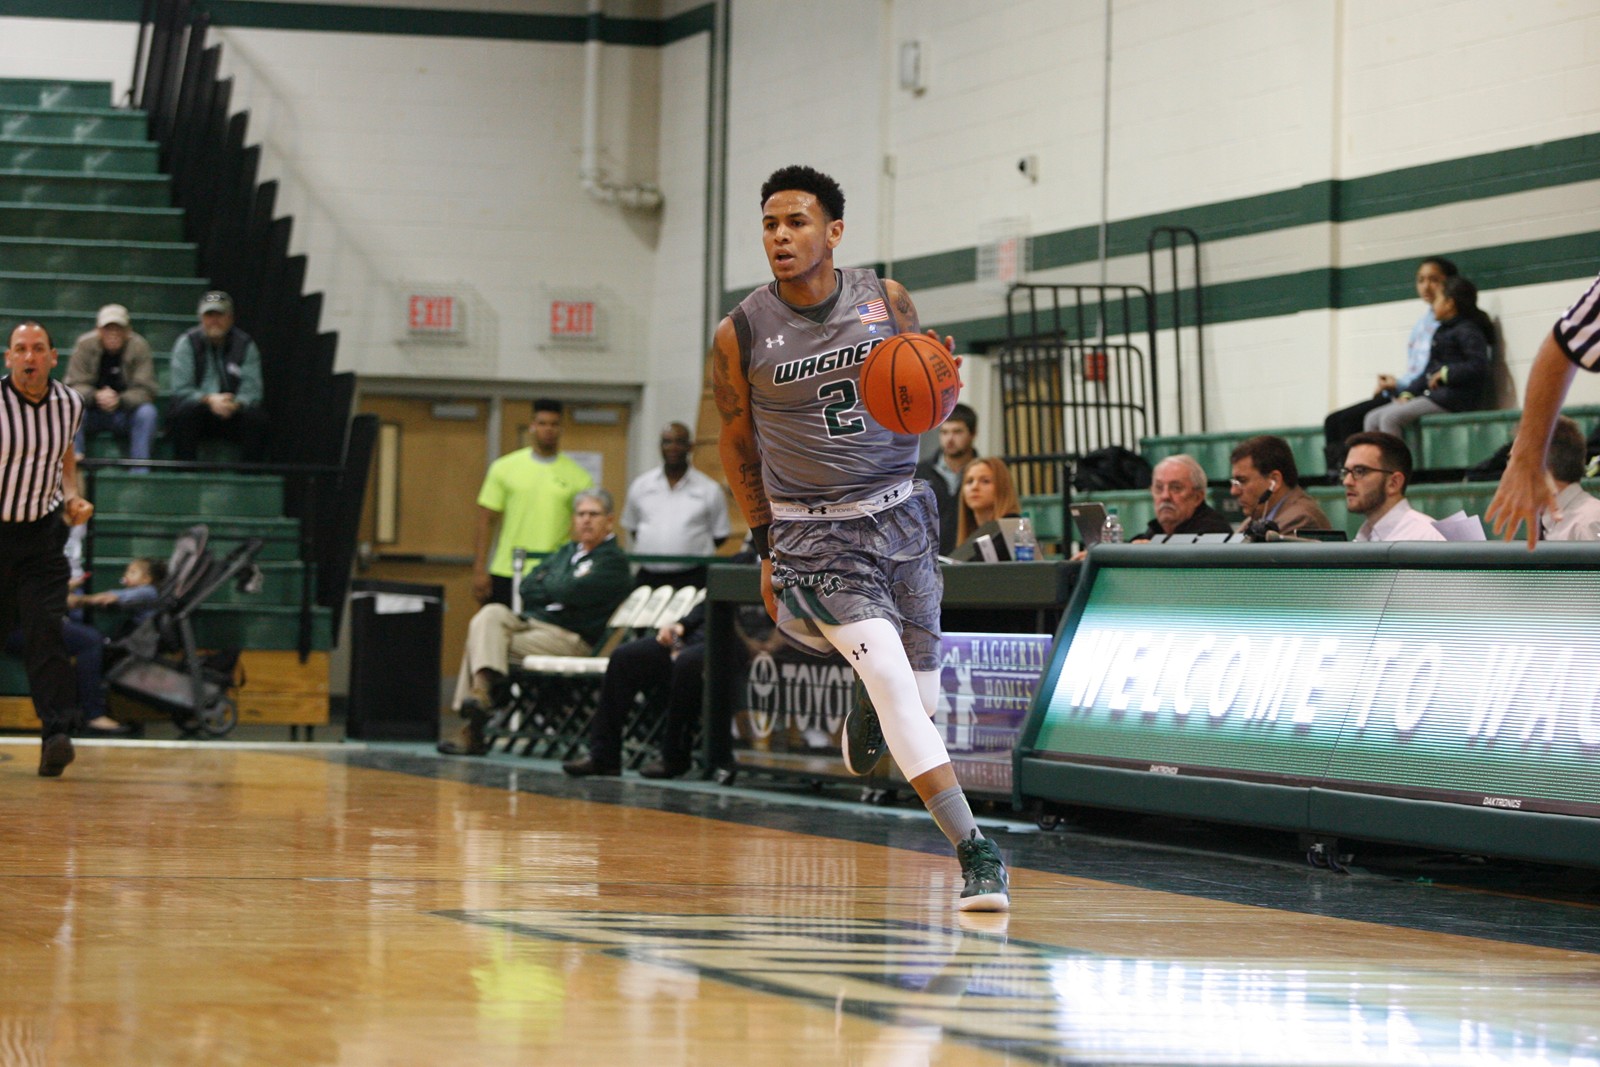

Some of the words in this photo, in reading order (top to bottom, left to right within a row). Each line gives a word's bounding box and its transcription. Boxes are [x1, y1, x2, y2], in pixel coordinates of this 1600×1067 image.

[409, 295, 453, 329] EXIT
[552, 301, 594, 334] EXIT
[929, 354, 952, 383] THE
[817, 378, 867, 438] 2
[898, 386, 911, 413] ROCK
[971, 639, 1045, 671] HAGGERTY
[984, 678, 1032, 710] HOMES
[1069, 630, 1342, 723] WELCOME
[1356, 638, 1442, 731] TO
[781, 663, 856, 736] TOYOT
[1482, 796, 1522, 809] DAKTRONICS
